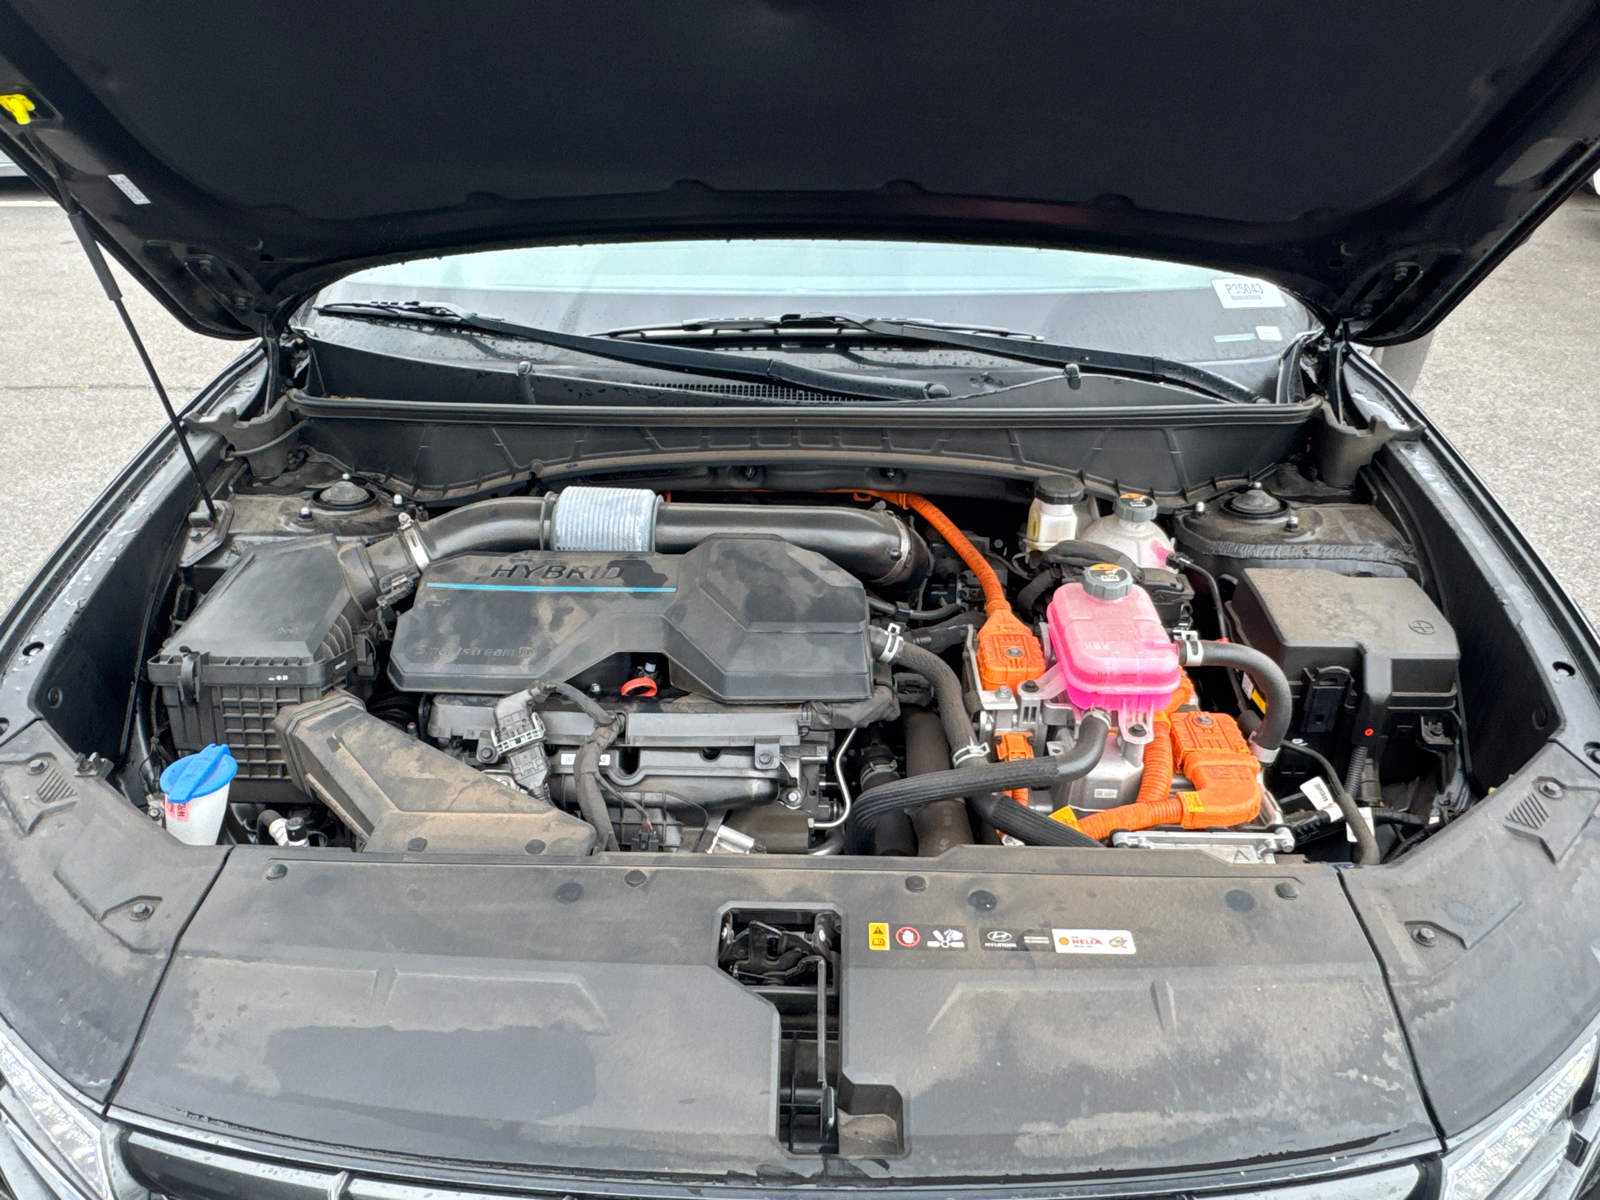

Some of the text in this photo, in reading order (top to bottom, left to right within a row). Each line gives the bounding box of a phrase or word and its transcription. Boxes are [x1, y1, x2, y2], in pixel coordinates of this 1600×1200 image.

[1225, 283, 1264, 294] P35043
[490, 564, 624, 580] HYBRID
[1072, 937, 1103, 945] HELIX
